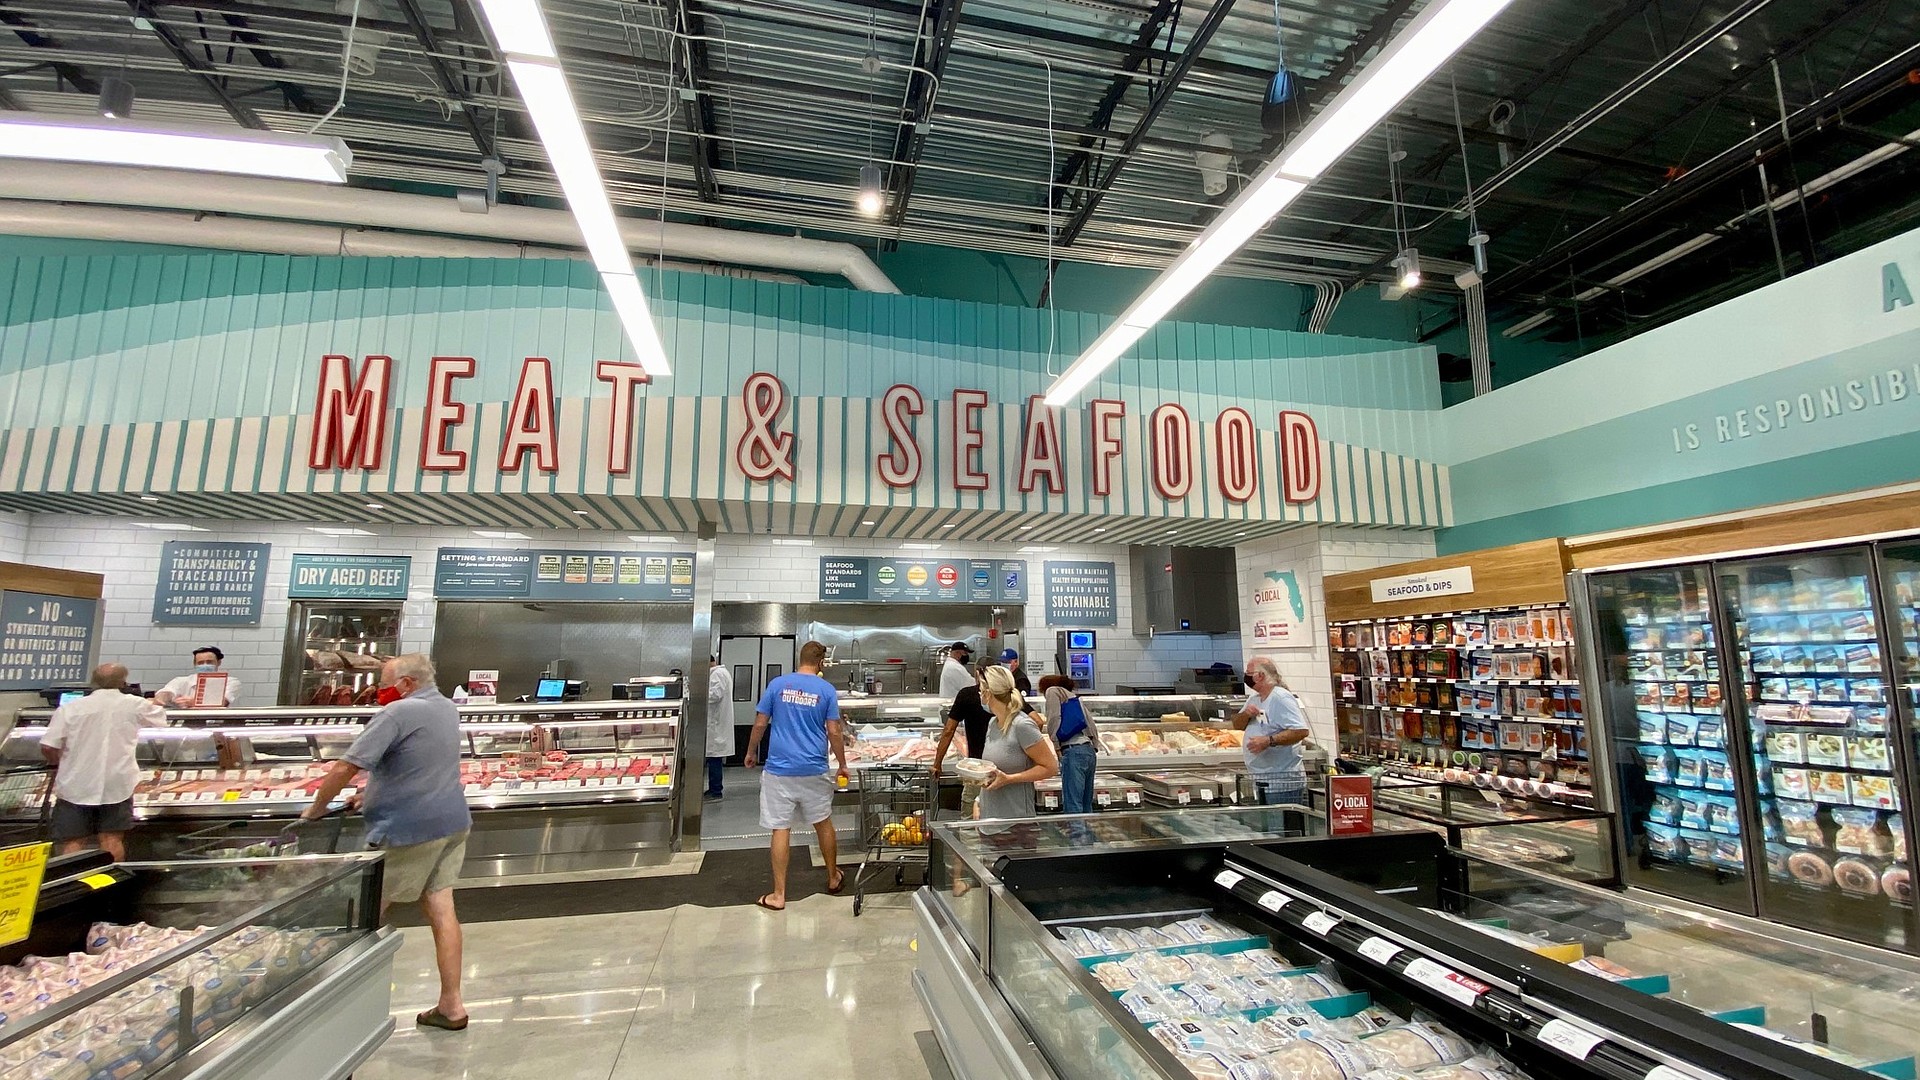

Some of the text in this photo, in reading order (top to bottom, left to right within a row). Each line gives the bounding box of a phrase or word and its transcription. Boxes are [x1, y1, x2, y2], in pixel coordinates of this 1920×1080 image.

[308, 354, 1321, 503] MEAT & SEAFOOD
[1672, 423, 1700, 454] IS
[180, 549, 258, 558] COMMITTED TO
[172, 559, 256, 570] TRANSPARENCY &
[171, 570, 255, 582] TRACEABILITY
[299, 567, 402, 586] DRY AGED BEEF
[183, 583, 206, 591] FARM
[210, 583, 220, 591] OR
[225, 584, 253, 592] RANCH
[1388, 585, 1424, 596] SEAFOOD
[1433, 581, 1452, 590] DIPS
[173, 596, 183, 604] NO
[185, 596, 209, 605] ADDED
[1052, 596, 1110, 608] SUSTAINABLE
[1262, 590, 1280, 602] LOCAL
[41, 601, 60, 622] NO
[171, 607, 181, 615] NO
[183, 607, 229, 615] ANTIBIOTICS
[6, 623, 87, 638] SYNTHETIC NITRATES
[4, 638, 85, 651] OR NITRITES IN OUR
[40, 654, 57, 665] HOT
[60, 654, 83, 666] DOGS
[0, 668, 81, 680] AND SAUSAGE
[782, 695, 817, 707] OUTDOORS
[1344, 797, 1368, 807] LOCAL
[4, 848, 37, 867] SALE
